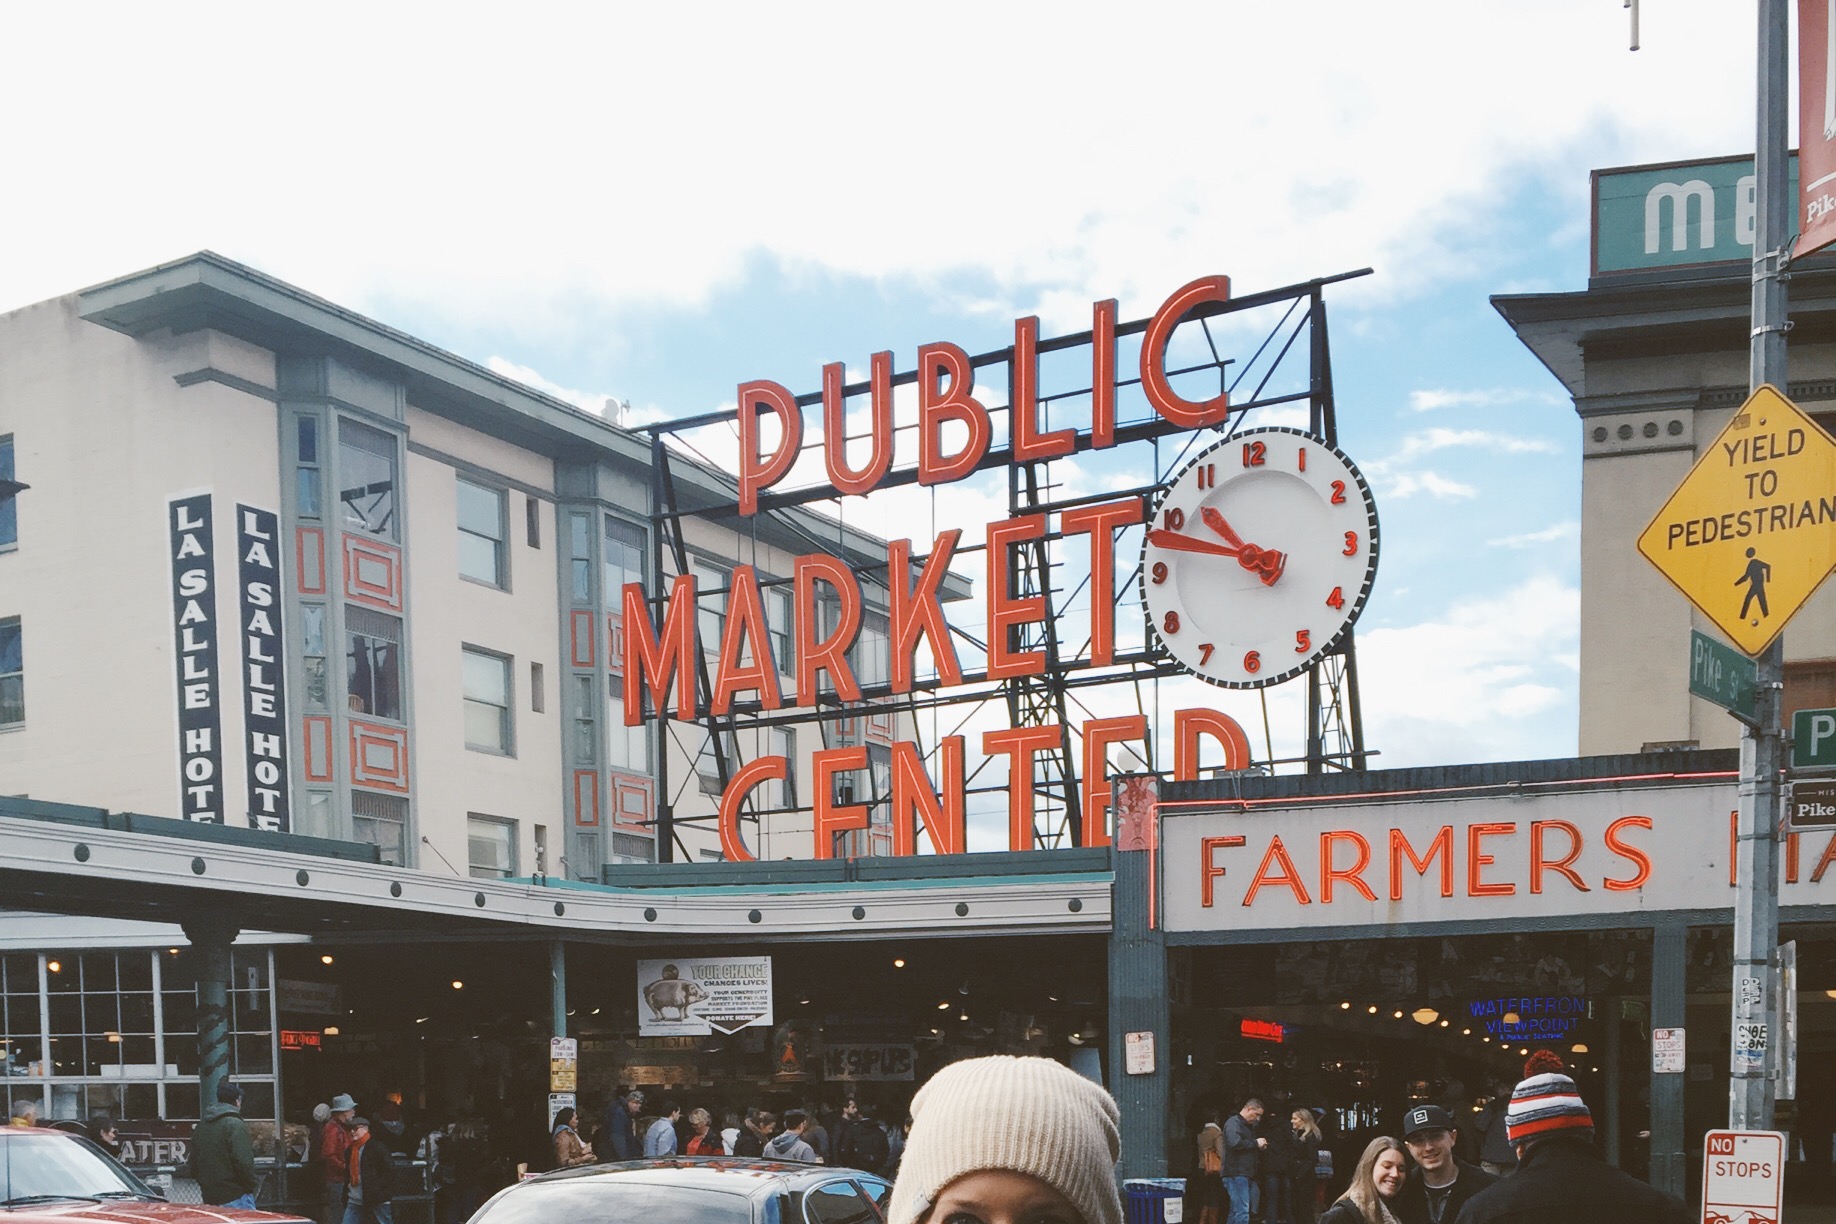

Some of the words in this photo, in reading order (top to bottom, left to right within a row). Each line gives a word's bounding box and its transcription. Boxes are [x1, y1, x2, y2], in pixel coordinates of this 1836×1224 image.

[1807, 193, 1836, 223] Pik
[738, 275, 1231, 516] PUBLIC
[1243, 441, 1267, 468] 12
[1299, 448, 1306, 472] 1
[1723, 429, 1805, 467] YIELD
[1198, 463, 1214, 489] 11
[1745, 470, 1778, 499] TO
[1331, 480, 1346, 504] 2
[1164, 508, 1184, 530] 10
[1668, 496, 1836, 550] PEDESTRIAN
[176, 506, 206, 560] LA
[244, 510, 273, 569] LA
[1343, 531, 1358, 556] 3
[1152, 562, 1168, 584] 9
[1326, 586, 1345, 609] 4
[623, 496, 1143, 726] MARKET
[1164, 611, 1180, 634] 8
[178, 569, 211, 710] SALLE
[247, 582, 277, 718] SALLE
[1295, 630, 1311, 652] 5
[1199, 643, 1215, 666] 7
[1244, 650, 1261, 674] 6
[1694, 637, 1722, 693] Pike
[1810, 715, 1836, 756] P
[1797, 803, 1836, 817] Pike
[1201, 816, 1653, 908] FARMERS
[691, 965, 720, 980] YOUR
[723, 964, 767, 980] CHANGE
[1486, 1018, 1579, 1034] VIEWPOINT
[1656, 1031, 1669, 1039] NO
[1658, 1040, 1681, 1049] STOPS
[1711, 1138, 1732, 1152] NO
[1715, 1161, 1771, 1178] STOPS
